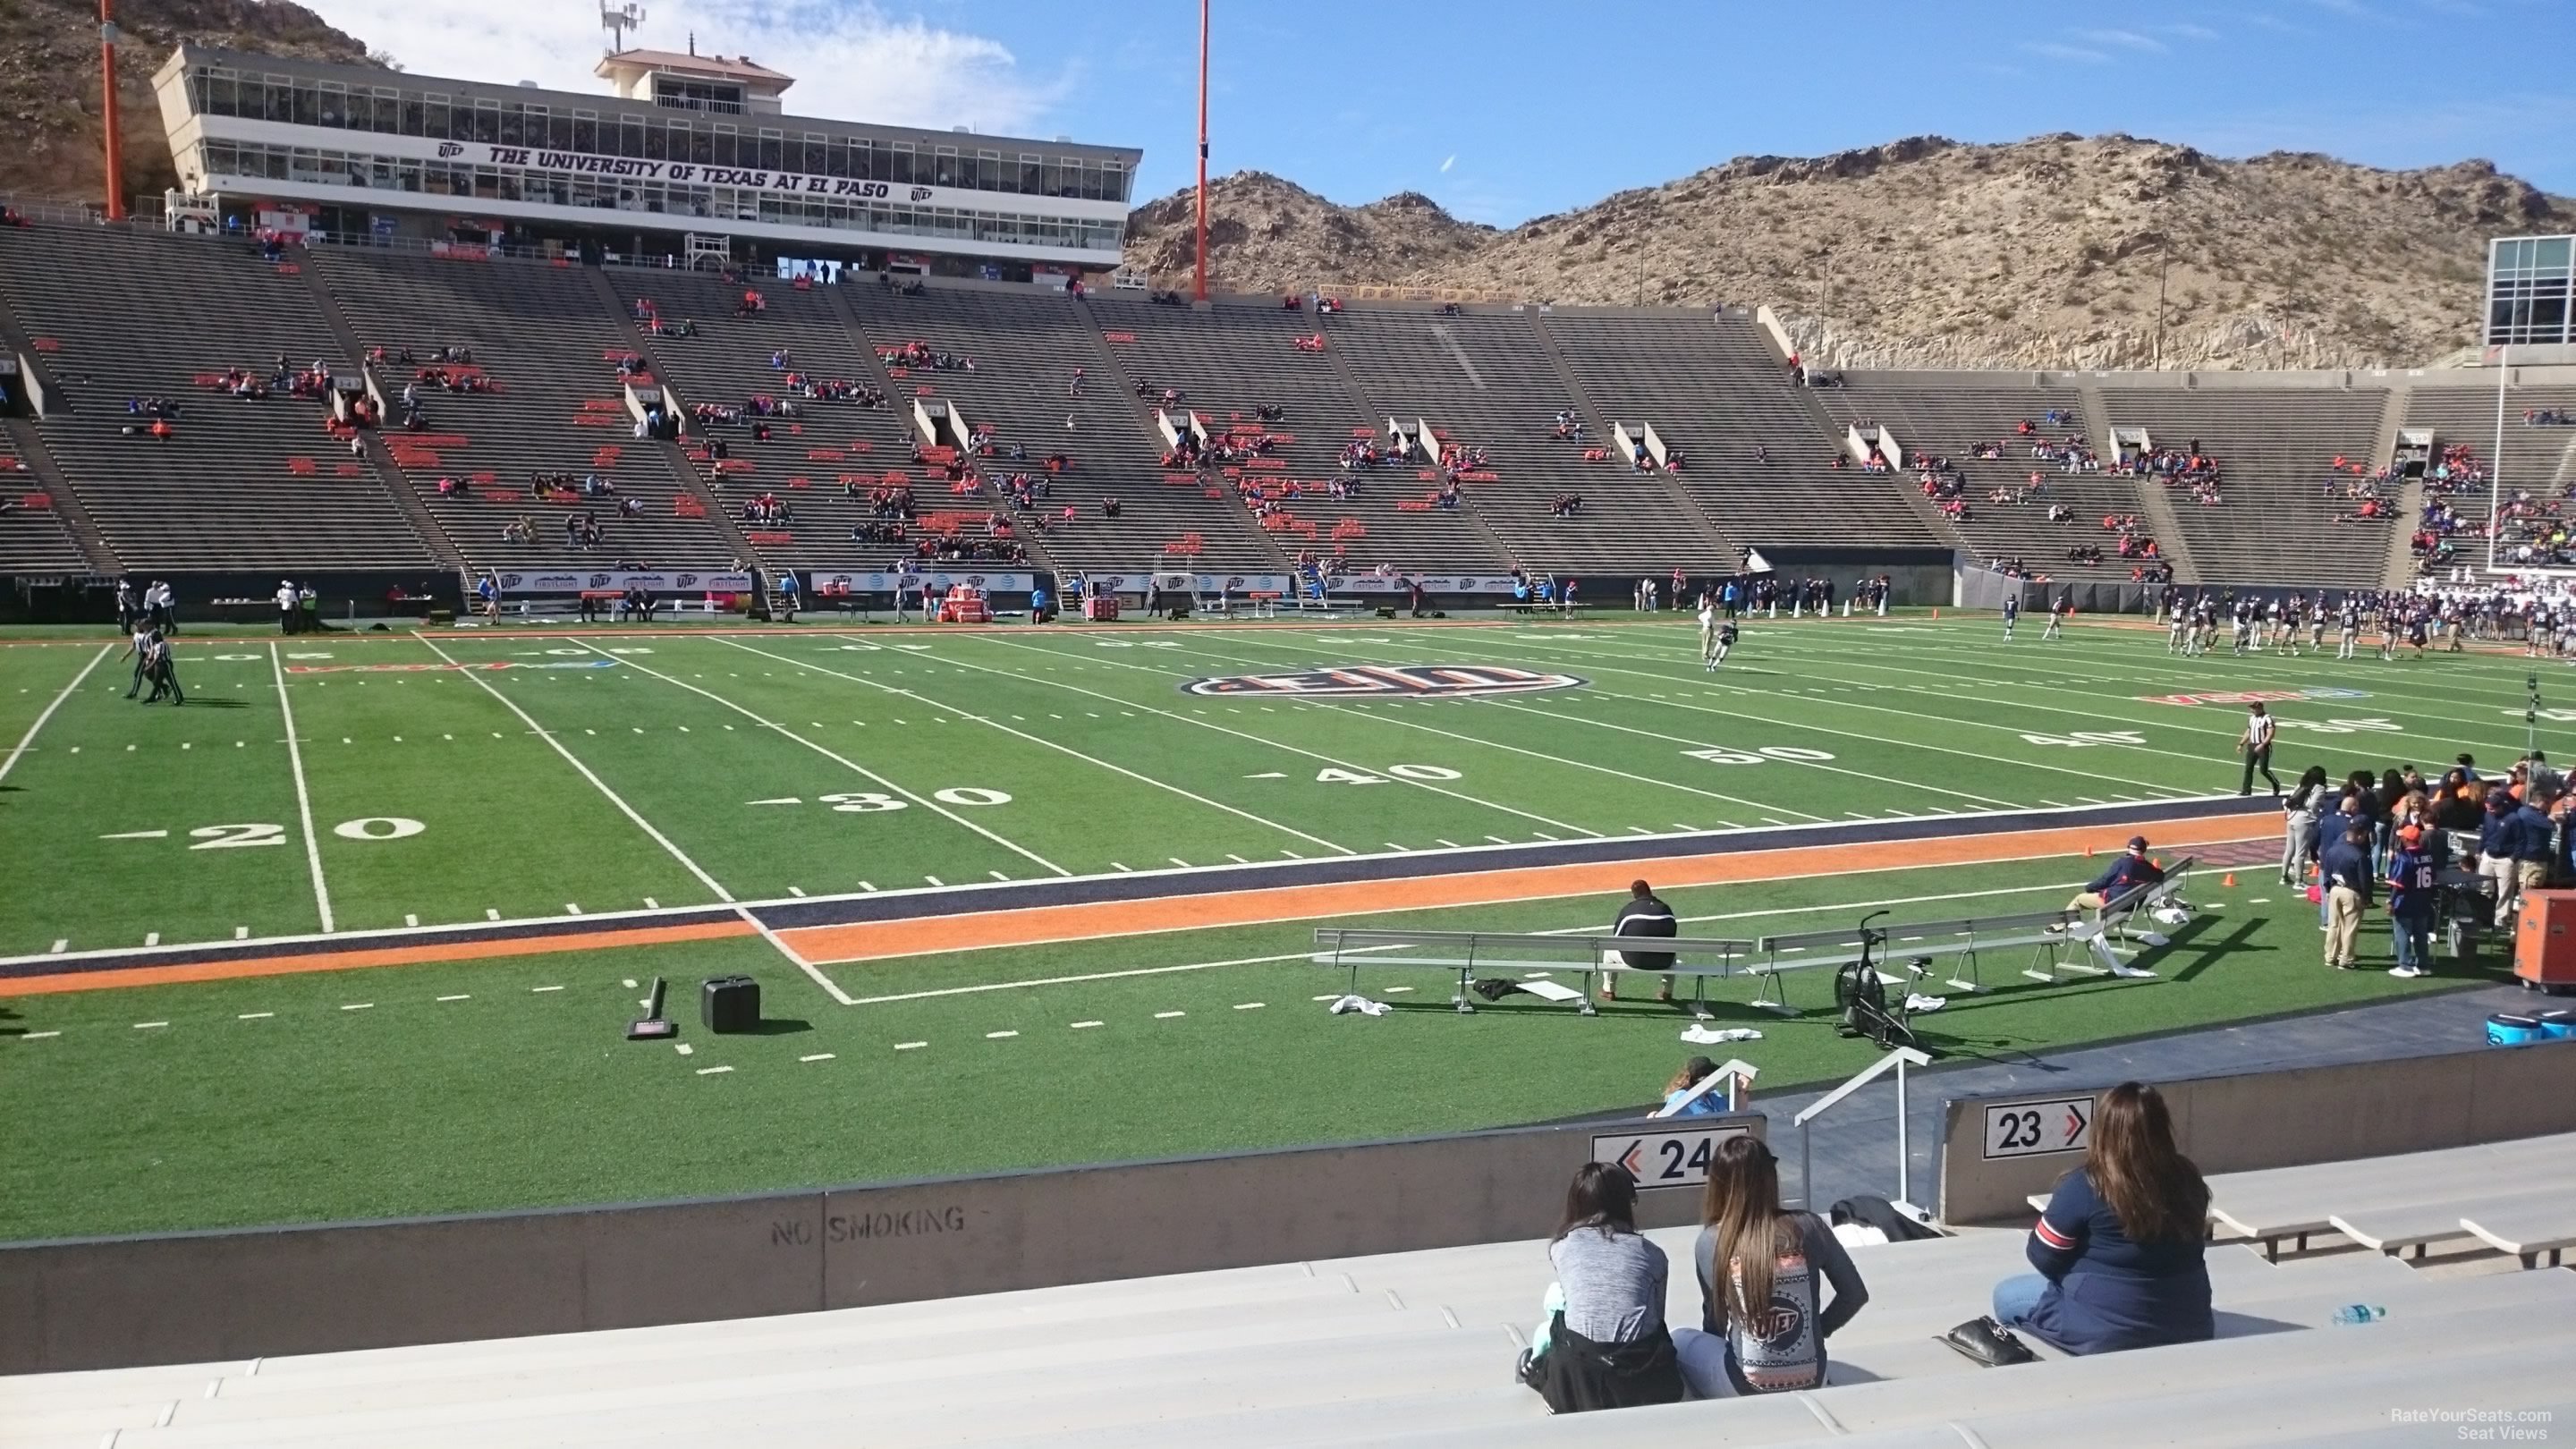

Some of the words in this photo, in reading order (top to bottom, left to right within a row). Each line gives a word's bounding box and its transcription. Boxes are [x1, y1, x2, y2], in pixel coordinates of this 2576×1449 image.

[438, 142, 464, 158] UTEP
[489, 147, 530, 165] THE
[538, 152, 664, 177] UNIVERSITY
[668, 165, 696, 181] OF
[702, 167, 768, 187] TEXAS
[774, 175, 803, 191] AT
[807, 177, 830, 192] EL
[834, 180, 889, 198] PASO
[911, 187, 933, 202] UTEP
[2415, 866, 2432, 888] 16
[1998, 1111, 2041, 1148] 23
[1660, 1138, 1711, 1179] 24
[771, 1219, 812, 1246] NO
[828, 1207, 964, 1243] SMOKING
